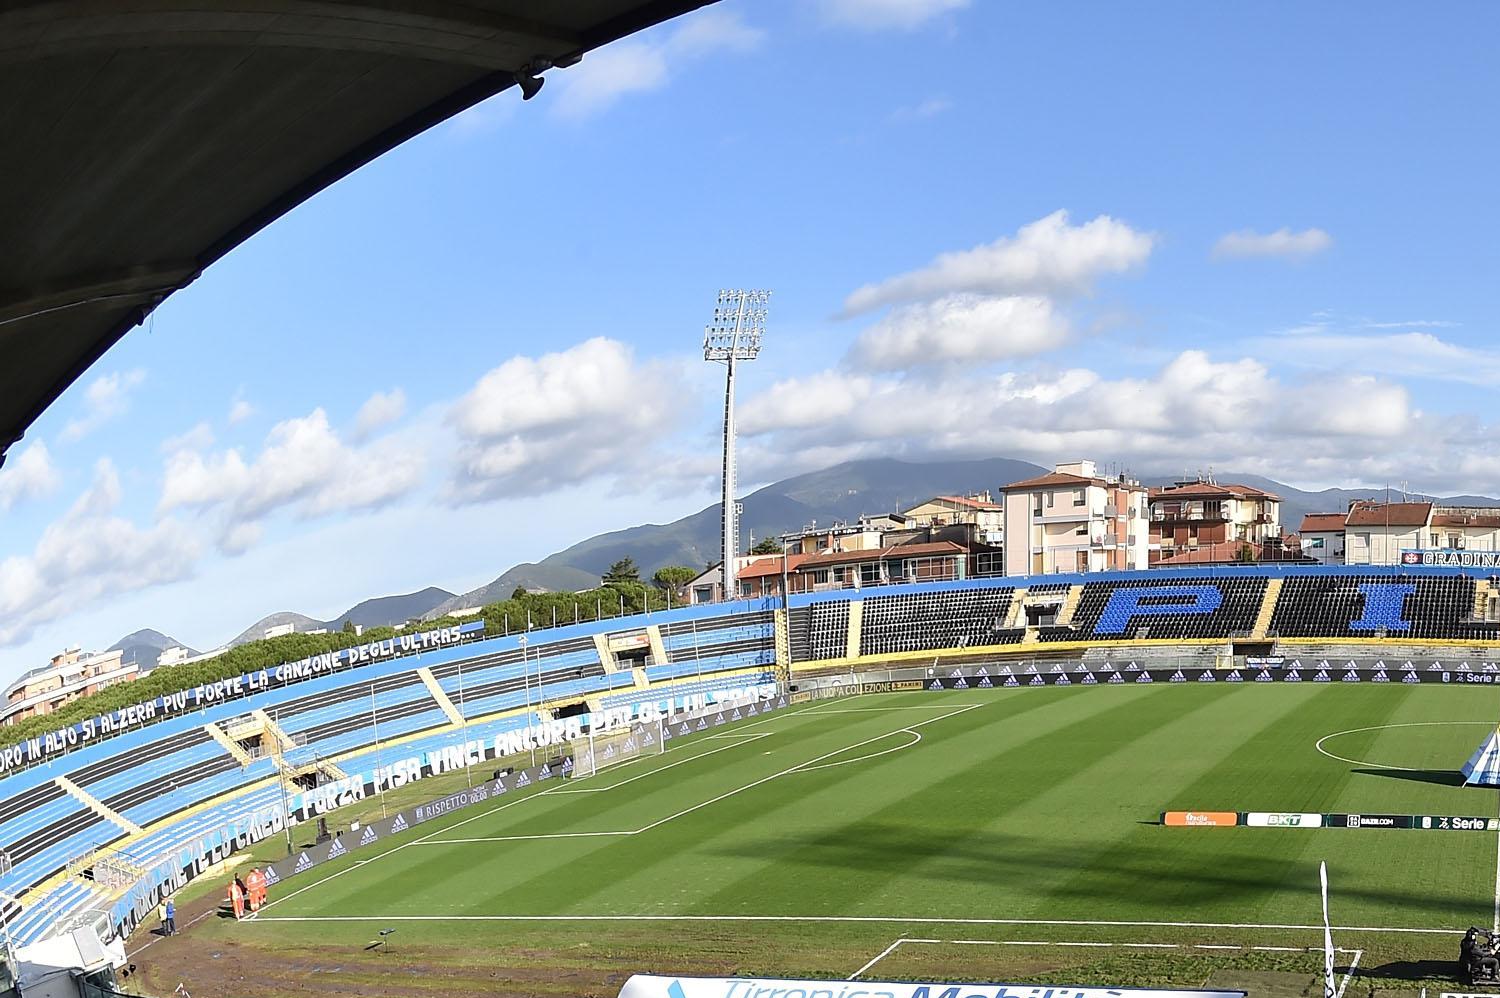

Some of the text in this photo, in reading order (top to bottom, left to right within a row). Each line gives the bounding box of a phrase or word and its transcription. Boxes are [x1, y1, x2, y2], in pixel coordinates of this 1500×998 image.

[1467, 673, 1492, 683] Serie
[28, 738, 41, 760] IN
[46, 726, 77, 752] ALTO
[83, 719, 96, 740] SI
[196, 676, 244, 705] FORTE
[248, 672, 269, 690] LA
[276, 650, 342, 682] CANZONE
[349, 640, 394, 664] DEGLI
[400, 626, 475, 651] ULTRAS...
[846, 682, 891, 696] COLLEZIONE
[303, 772, 366, 820] FORZA
[373, 756, 422, 796] PISA
[428, 738, 487, 777] VINCI
[495, 718, 584, 758] ANCORA
[426, 794, 468, 817] RISPETTO
[1267, 814, 1301, 825] BKT
[1452, 818, 1484, 830] Serie
